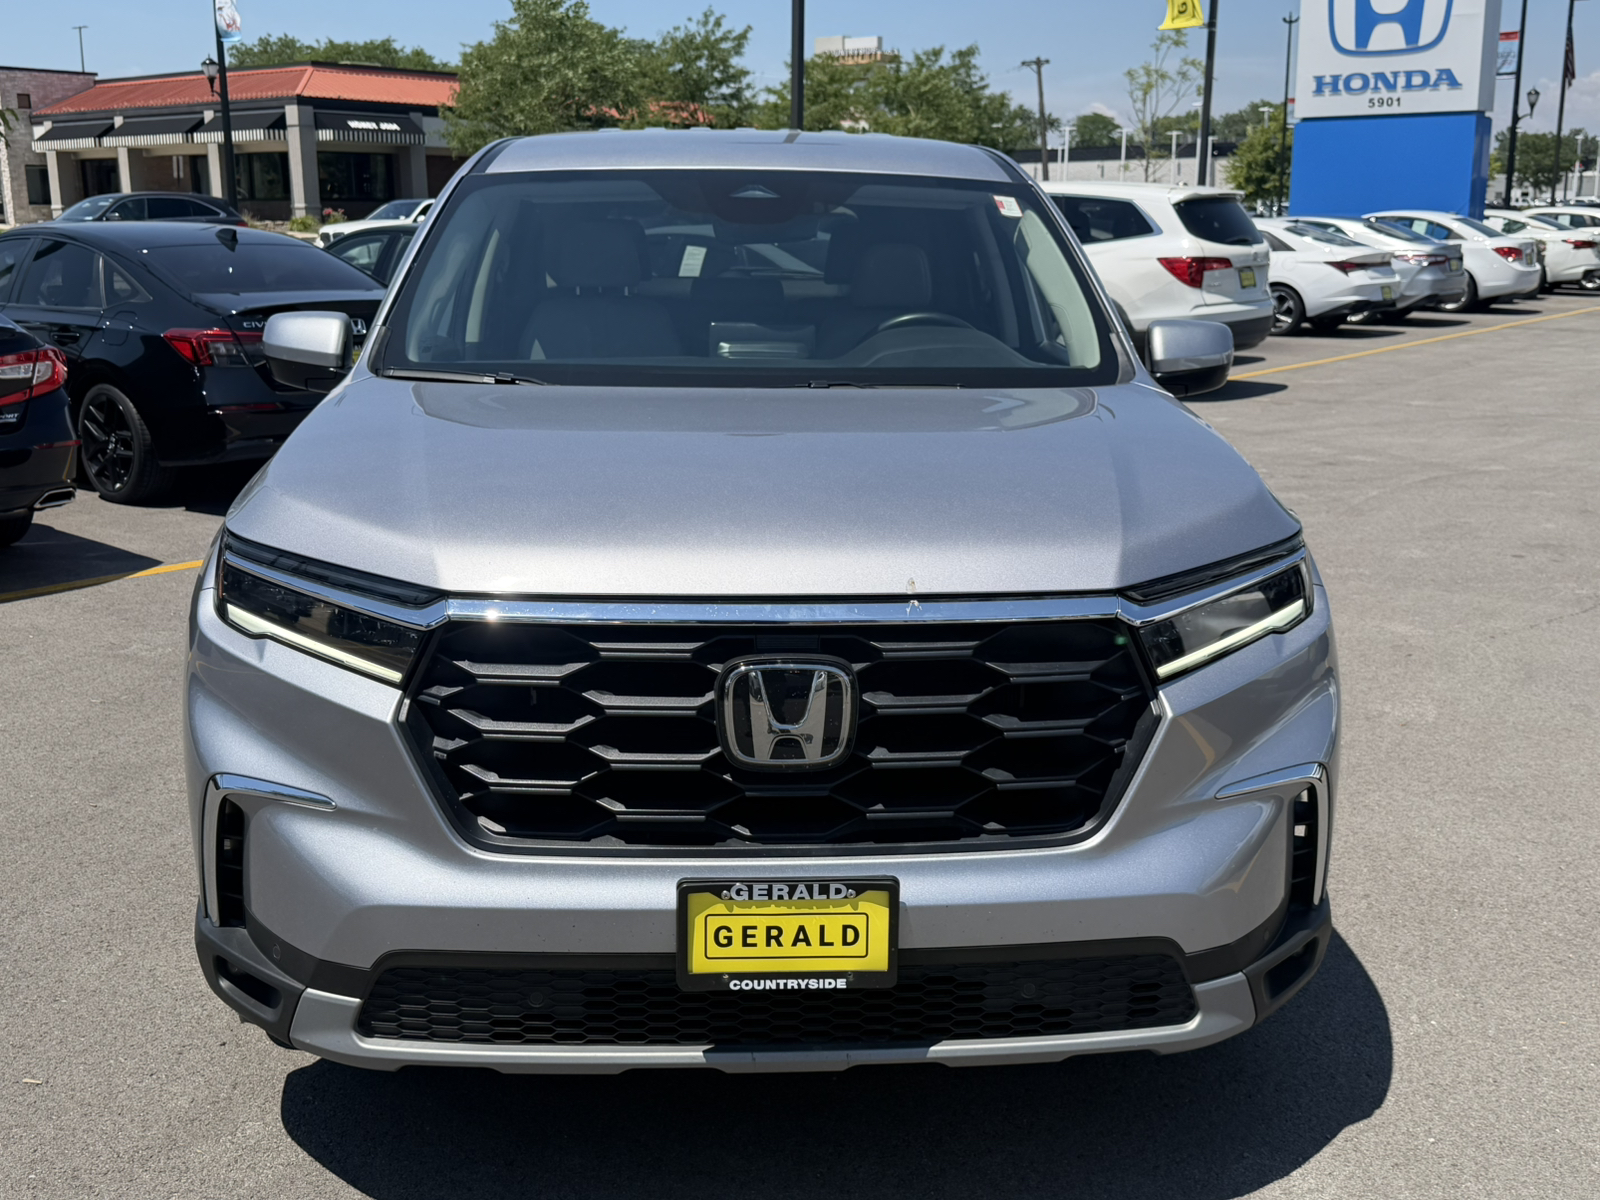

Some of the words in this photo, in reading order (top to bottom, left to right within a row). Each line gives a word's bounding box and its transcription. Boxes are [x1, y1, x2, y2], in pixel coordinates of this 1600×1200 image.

[1312, 69, 1463, 95] HONDA
[1368, 97, 1401, 108] 5901
[730, 883, 848, 901] GERALD
[713, 925, 860, 947] GERALD
[729, 979, 847, 990] COUNTRYSIDE
